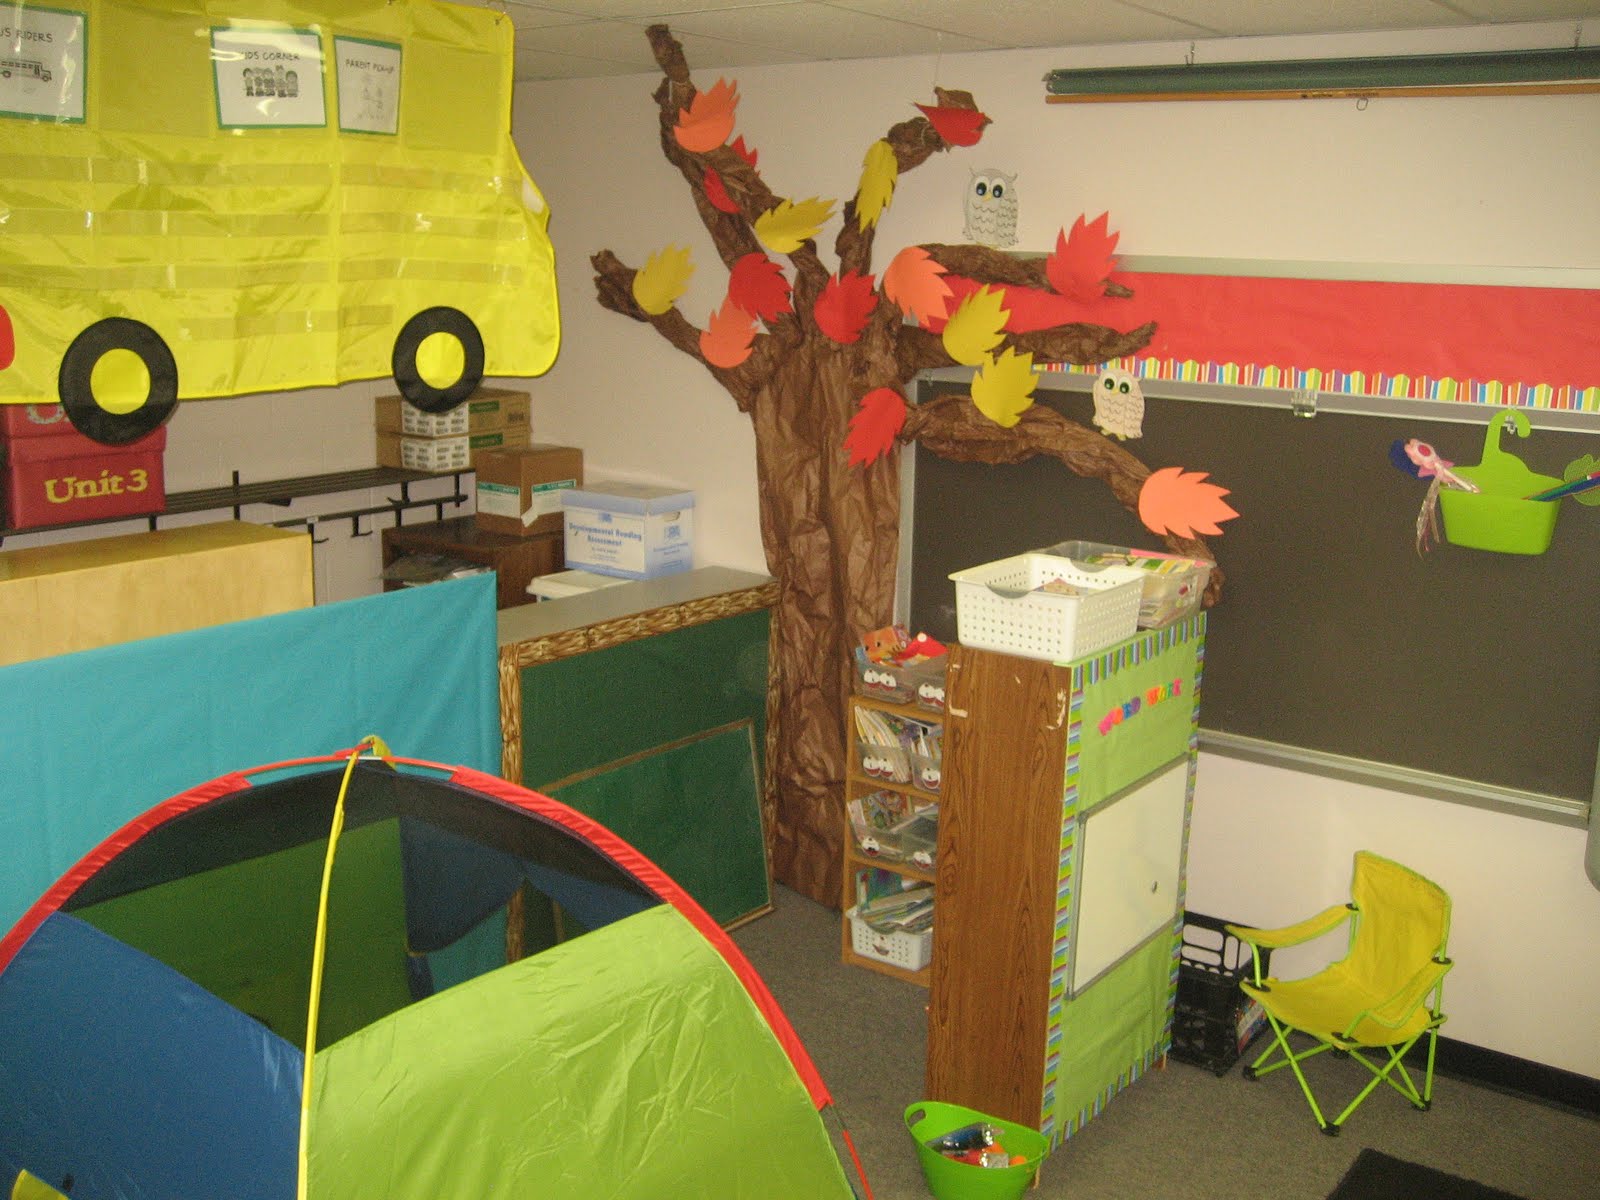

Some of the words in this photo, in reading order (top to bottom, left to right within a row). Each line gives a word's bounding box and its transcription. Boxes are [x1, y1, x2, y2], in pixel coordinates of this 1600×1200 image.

[16, 30, 53, 43] RIDERS
[240, 51, 259, 60] IDS
[262, 52, 300, 61] CORNER
[44, 469, 125, 504] Unit
[126, 469, 148, 492] 3
